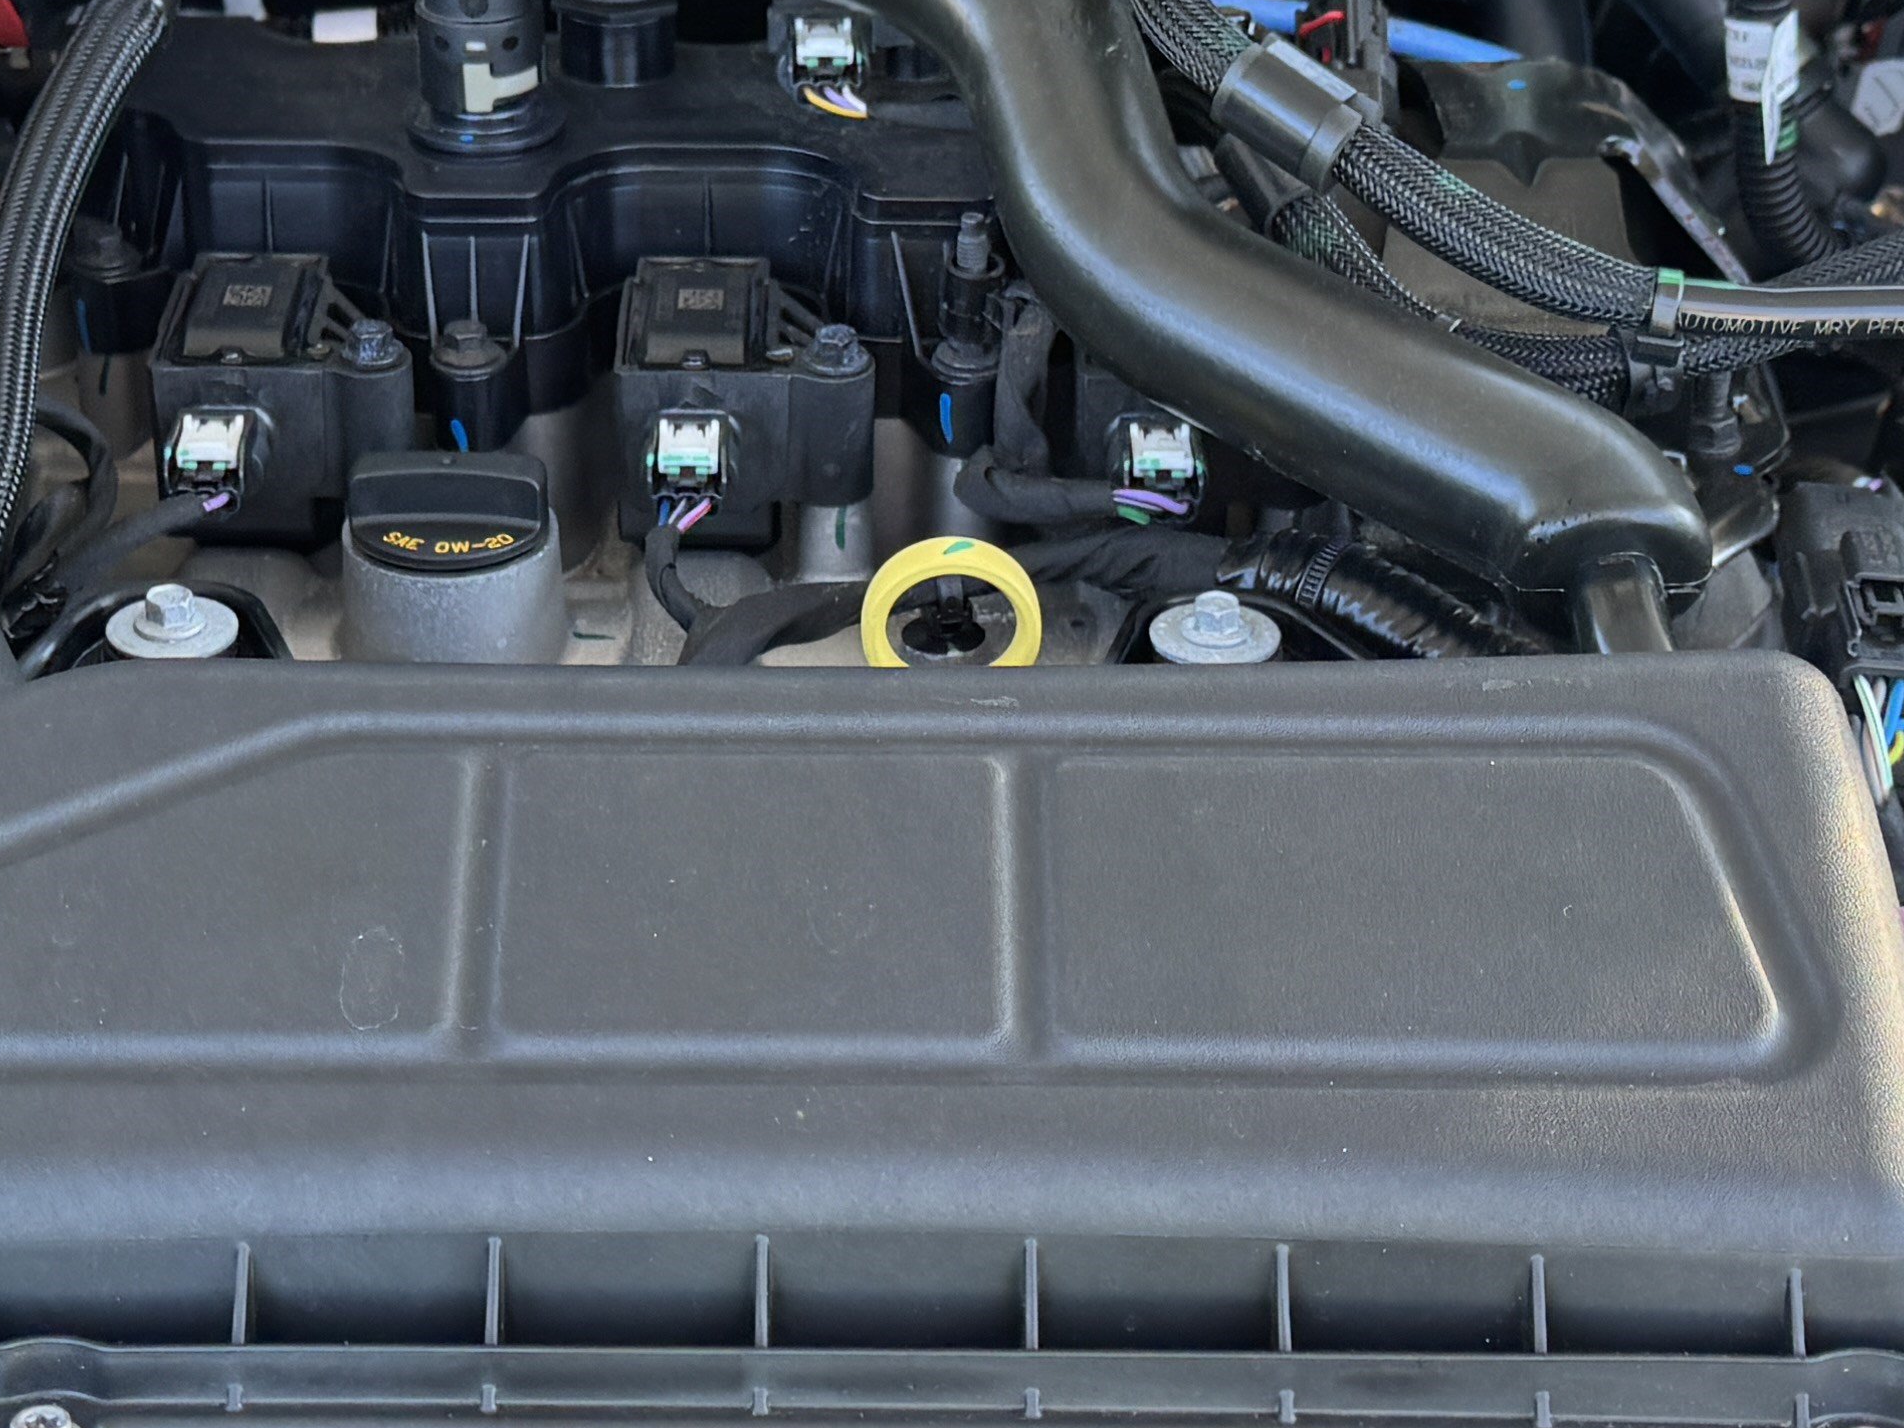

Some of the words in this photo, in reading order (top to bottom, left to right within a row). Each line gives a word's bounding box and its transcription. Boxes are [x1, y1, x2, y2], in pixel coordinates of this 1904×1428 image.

[1813, 318, 1859, 336] MRY
[382, 531, 426, 551] SAE
[434, 533, 515, 554] 0W-20
